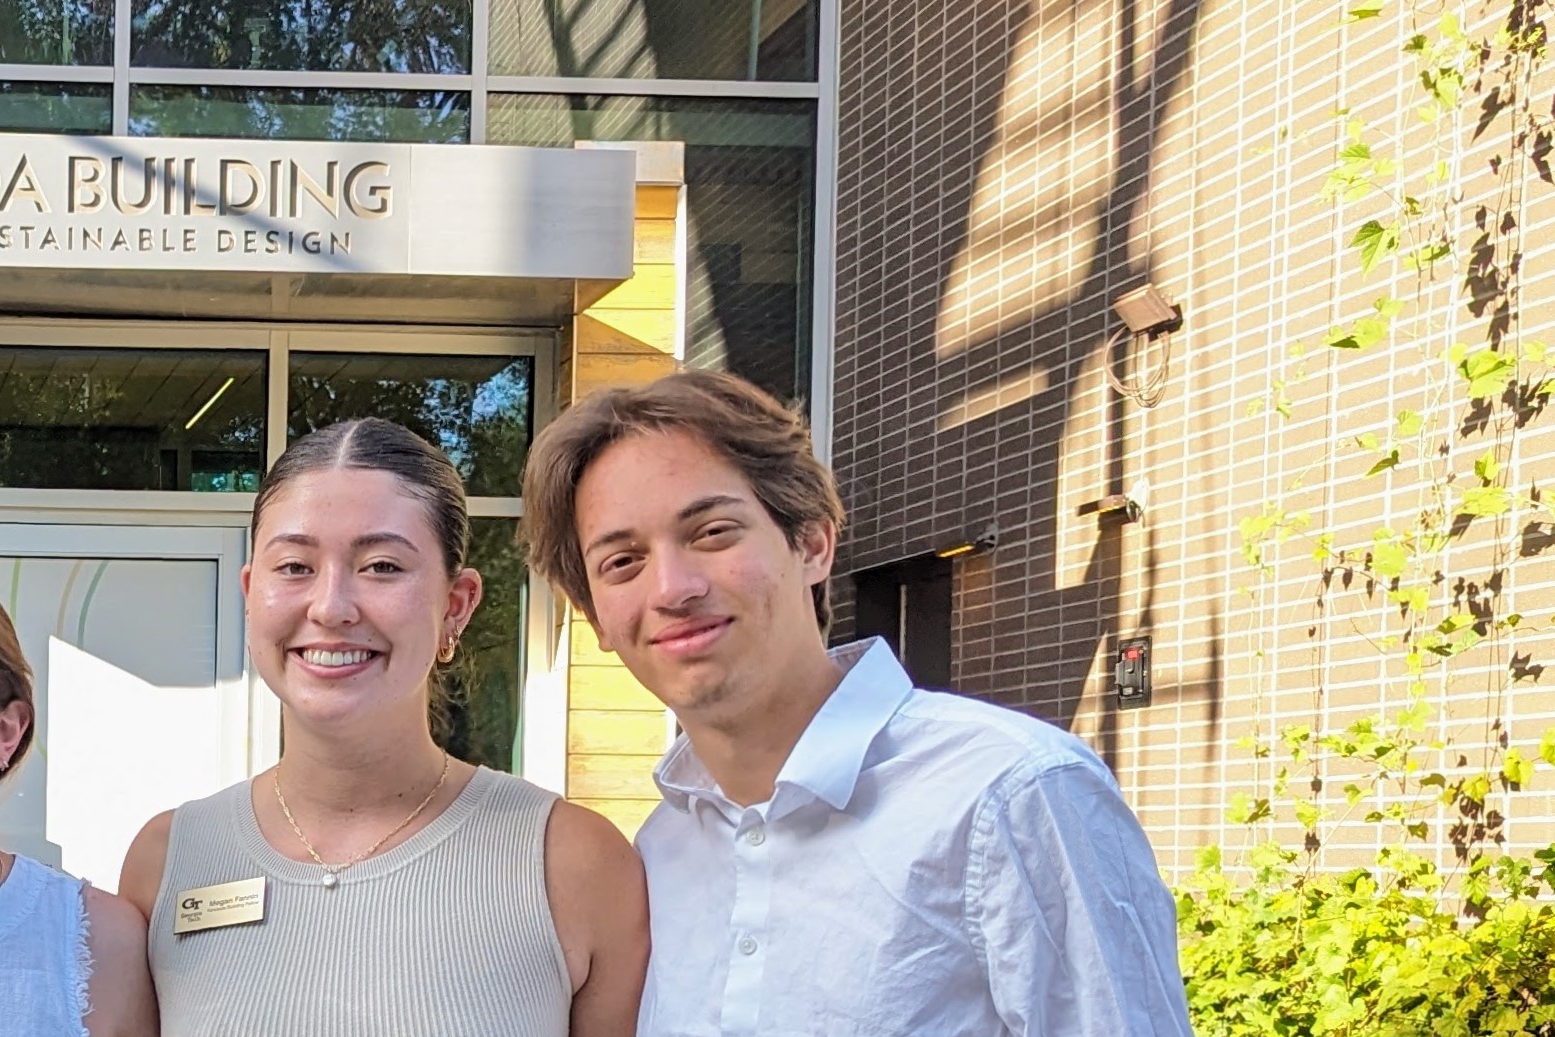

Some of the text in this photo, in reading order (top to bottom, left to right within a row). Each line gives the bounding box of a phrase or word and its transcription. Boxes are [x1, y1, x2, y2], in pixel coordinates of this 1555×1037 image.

[67, 155, 393, 221] BUILDING
[217, 228, 351, 256] DESIGN
[182, 898, 203, 910] GT
